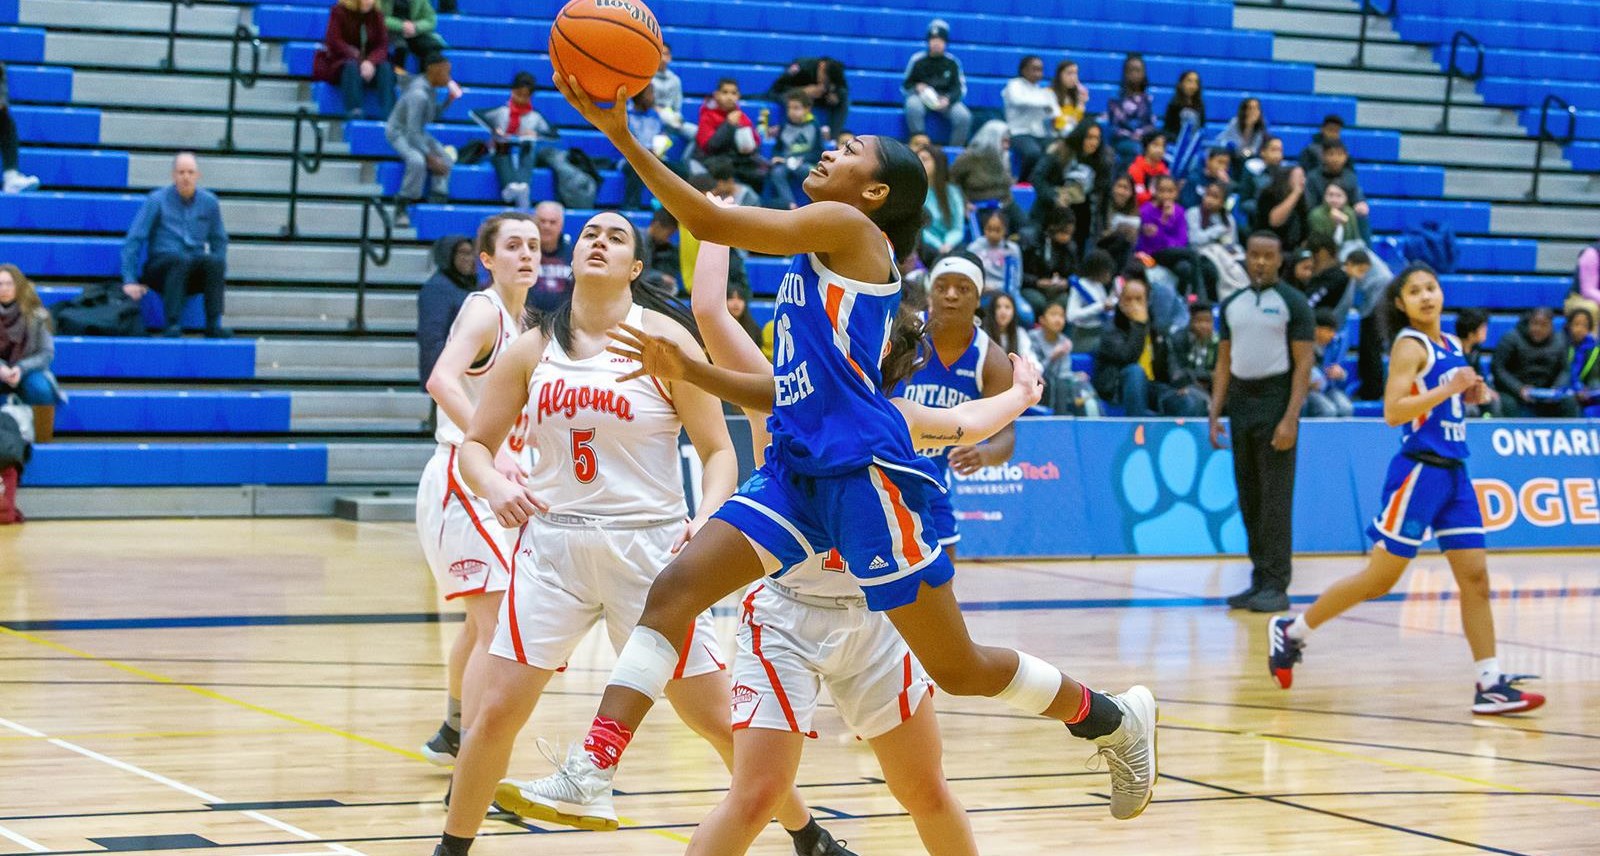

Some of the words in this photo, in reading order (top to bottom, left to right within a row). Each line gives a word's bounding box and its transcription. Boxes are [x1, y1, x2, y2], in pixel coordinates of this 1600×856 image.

[537, 378, 635, 425] Algoma
[774, 361, 815, 406] ECH
[570, 428, 598, 484] 5
[1492, 428, 1600, 456] ONTARI
[1471, 477, 1600, 531] DGE
